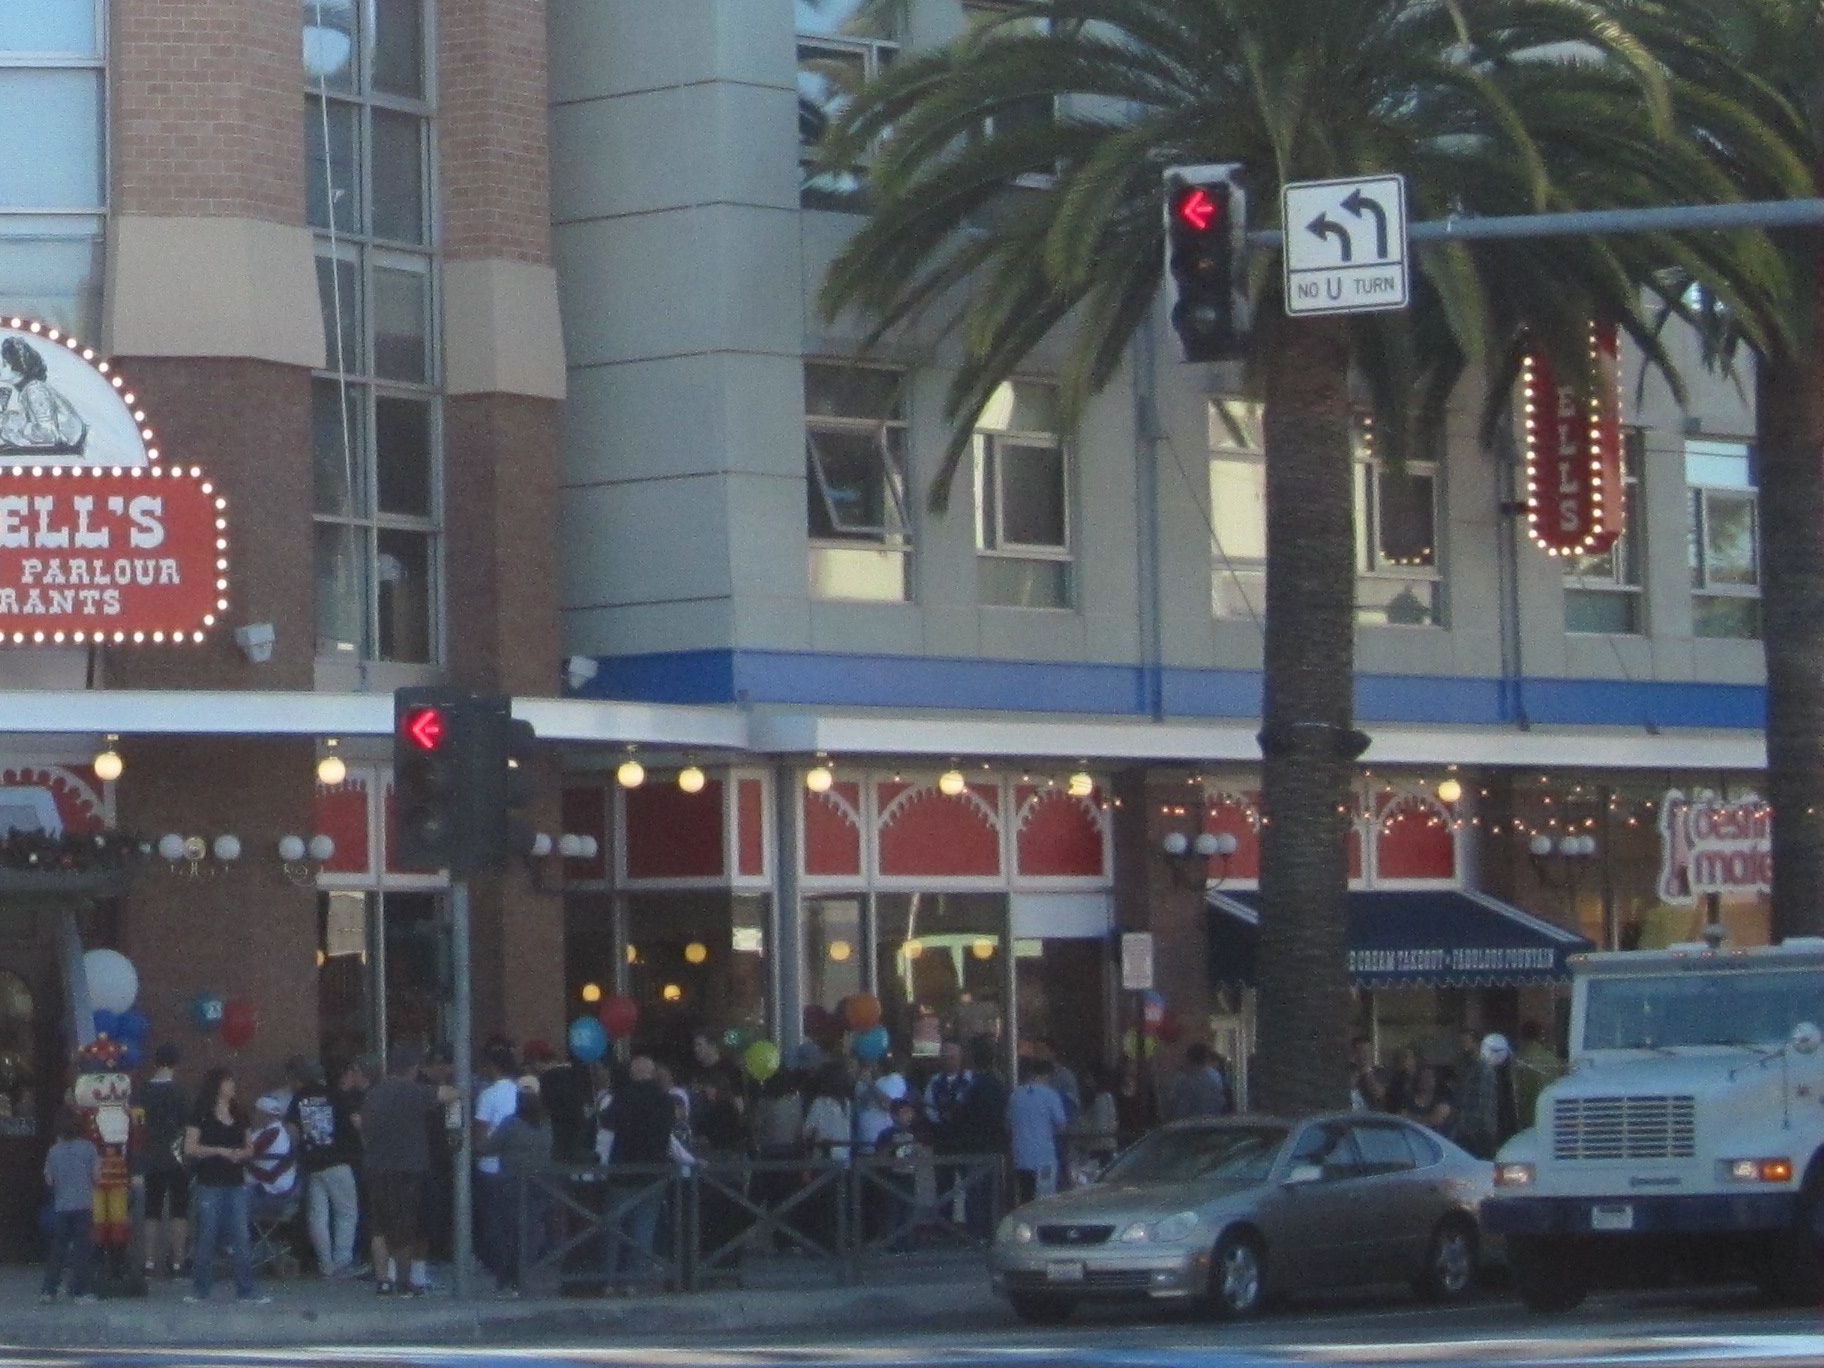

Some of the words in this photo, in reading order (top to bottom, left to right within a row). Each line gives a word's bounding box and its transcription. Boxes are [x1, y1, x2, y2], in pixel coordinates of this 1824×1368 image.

[1297, 282, 1319, 299] NO
[1327, 276, 1342, 300] U
[1353, 276, 1395, 294] TURN
[1557, 385, 1580, 532] ELLS
[21, 558, 181, 585] PARLOUR
